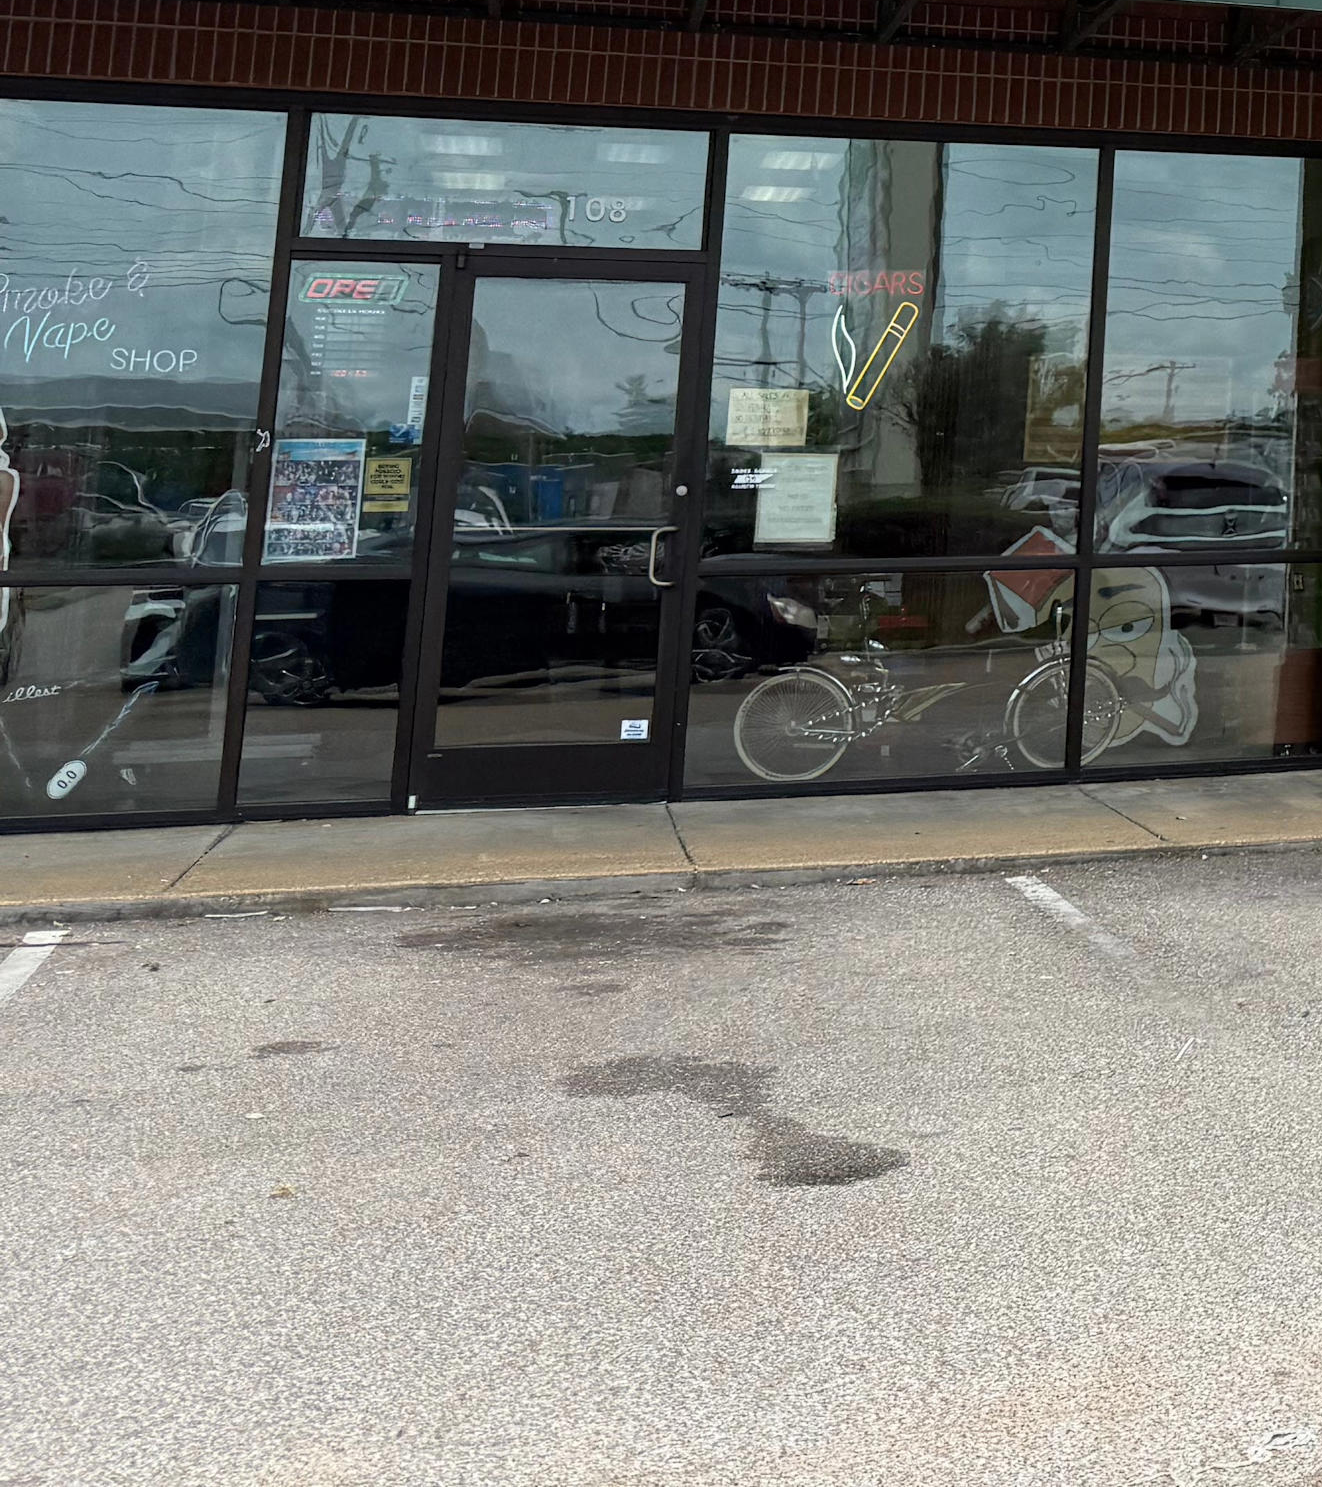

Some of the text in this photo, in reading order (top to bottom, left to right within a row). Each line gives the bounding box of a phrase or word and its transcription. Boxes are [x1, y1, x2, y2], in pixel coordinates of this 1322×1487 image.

[565, 195, 628, 223] 108
[306, 278, 401, 301] OPEN
[829, 272, 924, 296] CIGARS
[4, 311, 116, 363] Vape
[110, 347, 198, 373] SHOP
[2, 685, 62, 703] illest
